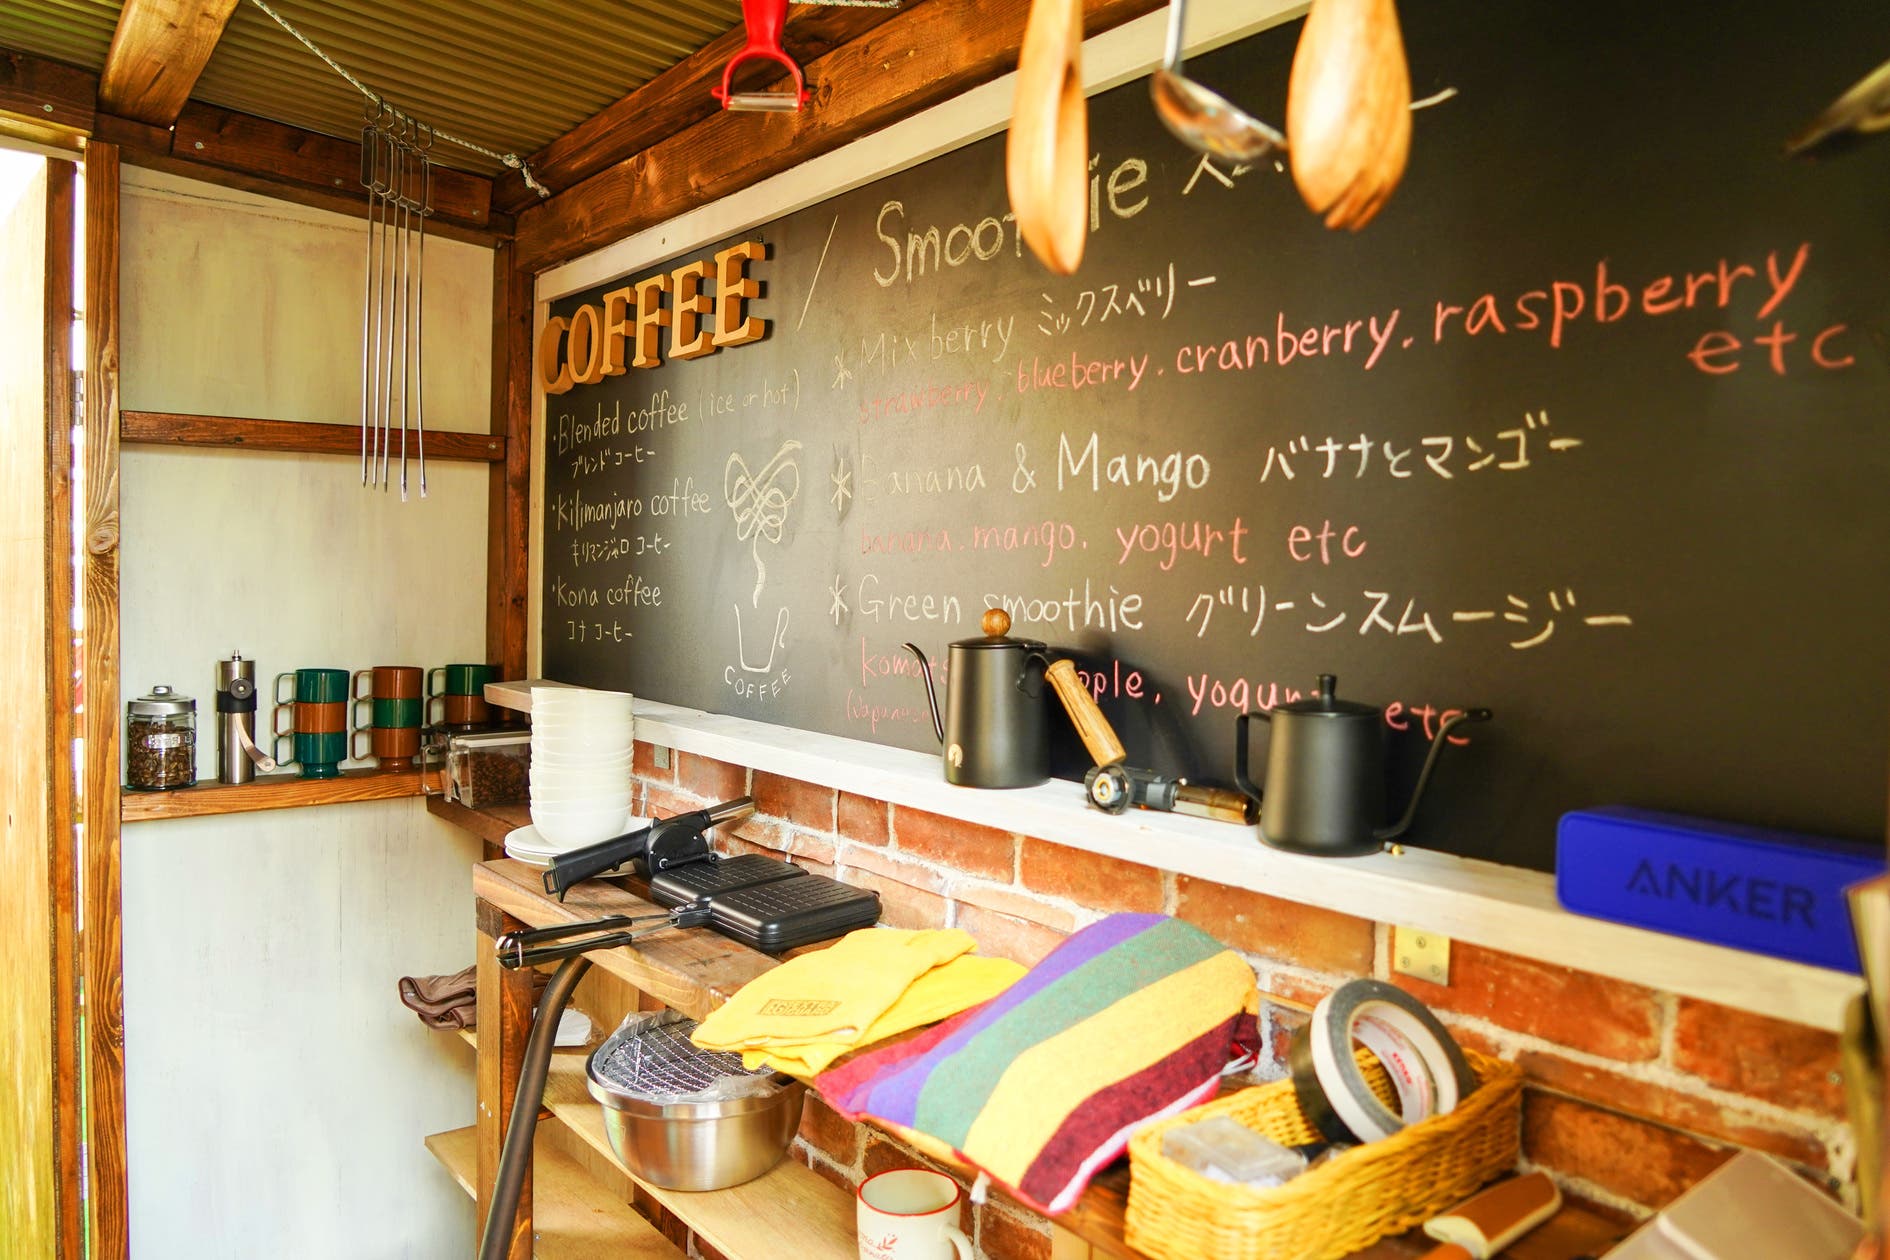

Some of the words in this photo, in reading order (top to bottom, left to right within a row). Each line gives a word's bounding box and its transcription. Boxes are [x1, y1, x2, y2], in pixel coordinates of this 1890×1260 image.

[538, 240, 767, 395] COFFEE
[1037, 262, 1217, 336] ミックスベリー
[1435, 242, 1811, 348] raspberry
[861, 332, 916, 377] Mix
[930, 313, 1014, 364] berry
[1686, 321, 1855, 375] etc
[558, 401, 620, 457] Blended
[627, 389, 689, 435] coffee
[699, 387, 735, 425] (ice
[742, 391, 758, 407] or
[763, 368, 800, 413] hot)
[615, 445, 656, 466] コーヒー
[1011, 441, 1037, 494] &
[1057, 430, 1211, 503] Mango
[1259, 410, 1584, 483] バナナとマンゴー
[557, 488, 643, 532] Kilimanjaro
[650, 476, 712, 517] coffee
[636, 532, 671, 555] コーヒー
[1116, 516, 1248, 571] yogurt
[1287, 520, 1367, 565] etc
[557, 575, 599, 608] Kona
[606, 574, 663, 608] coffee
[858, 573, 961, 625] Green
[1186, 584, 1633, 651] グリーンスムージー
[595, 620, 633, 643] コーヒー
[724, 665, 792, 702] COFFEE
[1187, 673, 1321, 717] yogur
[1625, 857, 1817, 929] ANKER
